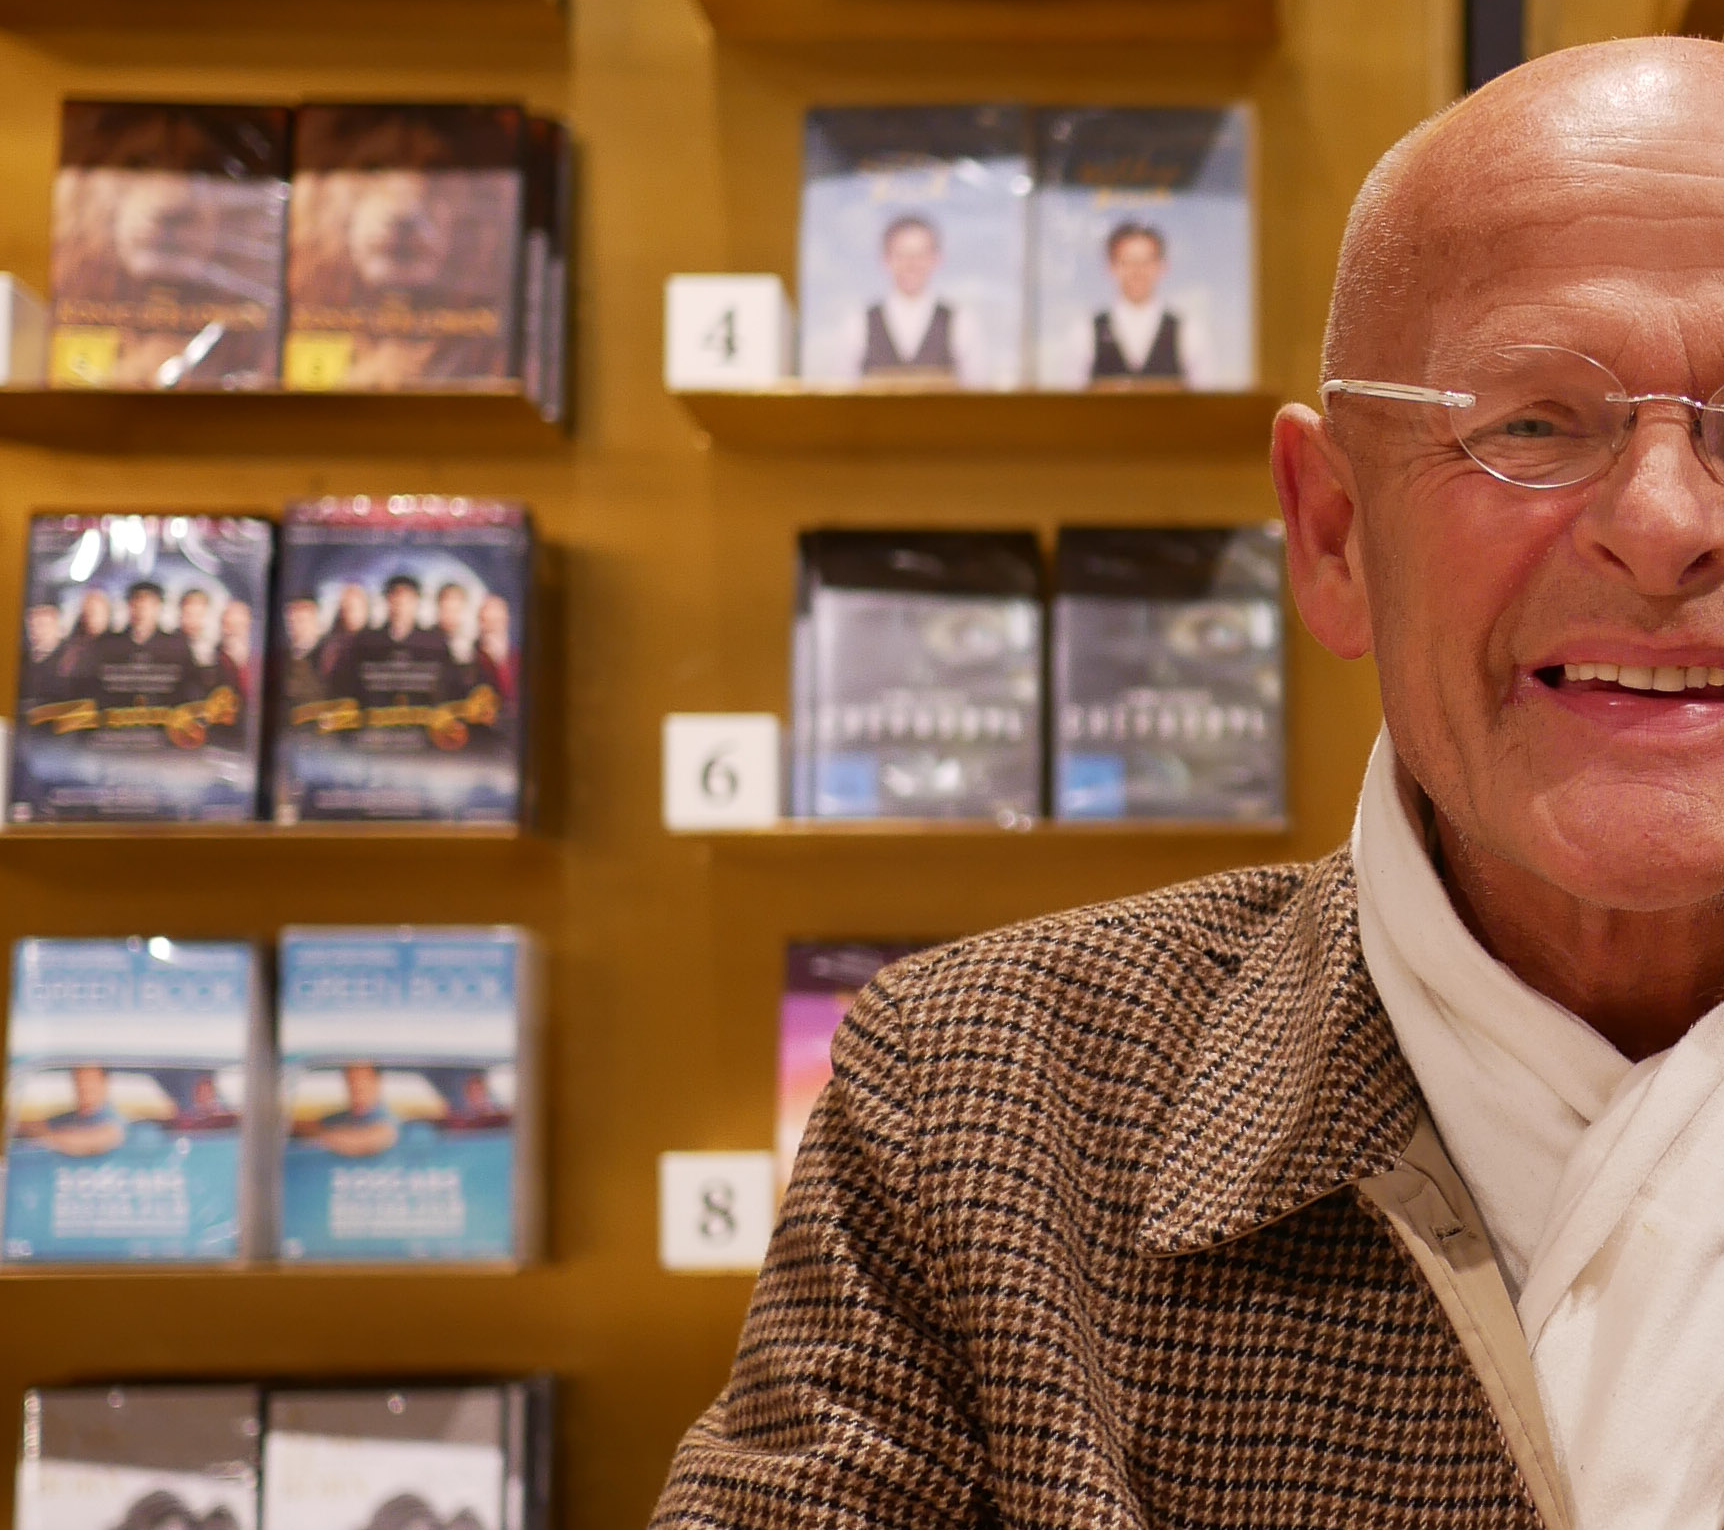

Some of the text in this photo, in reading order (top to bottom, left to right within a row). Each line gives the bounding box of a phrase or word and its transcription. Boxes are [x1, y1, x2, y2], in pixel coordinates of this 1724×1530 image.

[700, 308, 740, 363] 4
[697, 741, 740, 800] 6
[696, 1185, 739, 1240] 8
